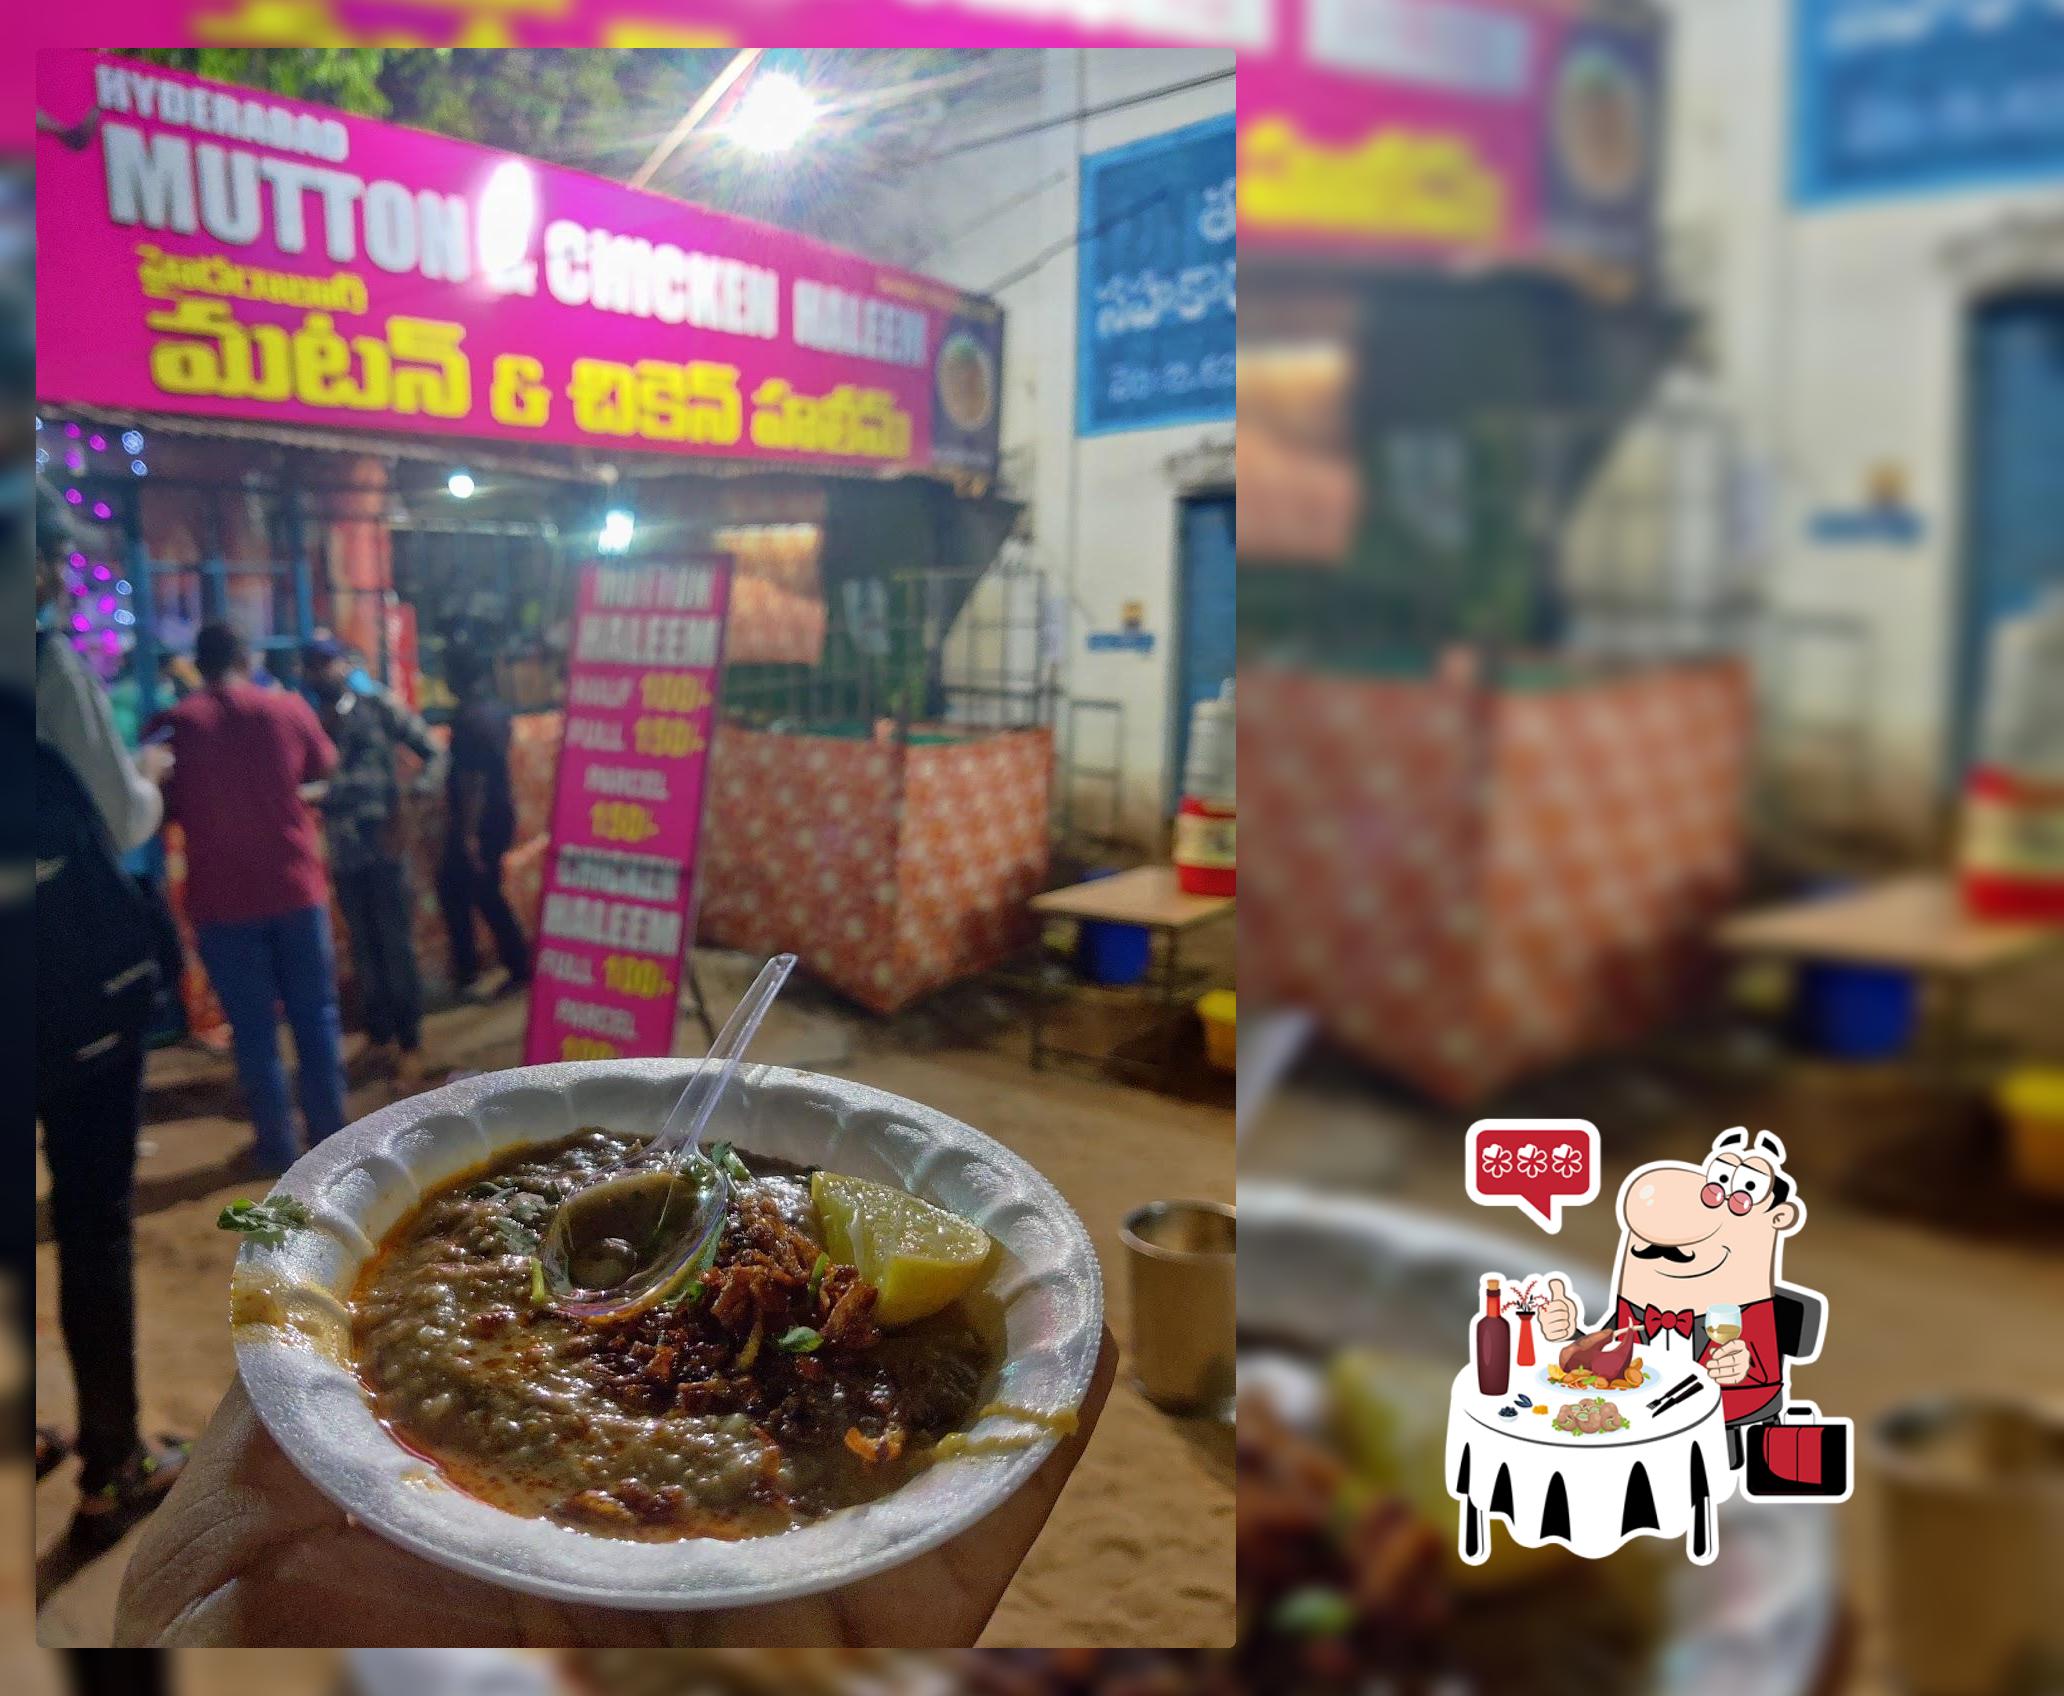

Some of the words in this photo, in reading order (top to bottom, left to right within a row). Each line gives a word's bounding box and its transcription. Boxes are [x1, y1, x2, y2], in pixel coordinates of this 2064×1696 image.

[96, 64, 349, 162] HYDERABAD
[103, 123, 468, 283] MUTTON
[544, 220, 780, 339] CHICKEN
[793, 279, 928, 367] HALEEM
[146, 298, 471, 418] మటన్
[490, 354, 551, 428] &
[567, 357, 743, 446] చికెన్
[593, 565, 715, 609] MUTTON
[577, 613, 721, 667] HALEEM
[570, 675, 634, 709] HALF
[566, 717, 624, 752] FULL
[584, 764, 669, 800] PARCEL
[557, 843, 682, 902] CHICKEN
[543, 892, 683, 956] HALEEM
[537, 949, 594, 985] FULL
[555, 998, 637, 1041] PARCEL
